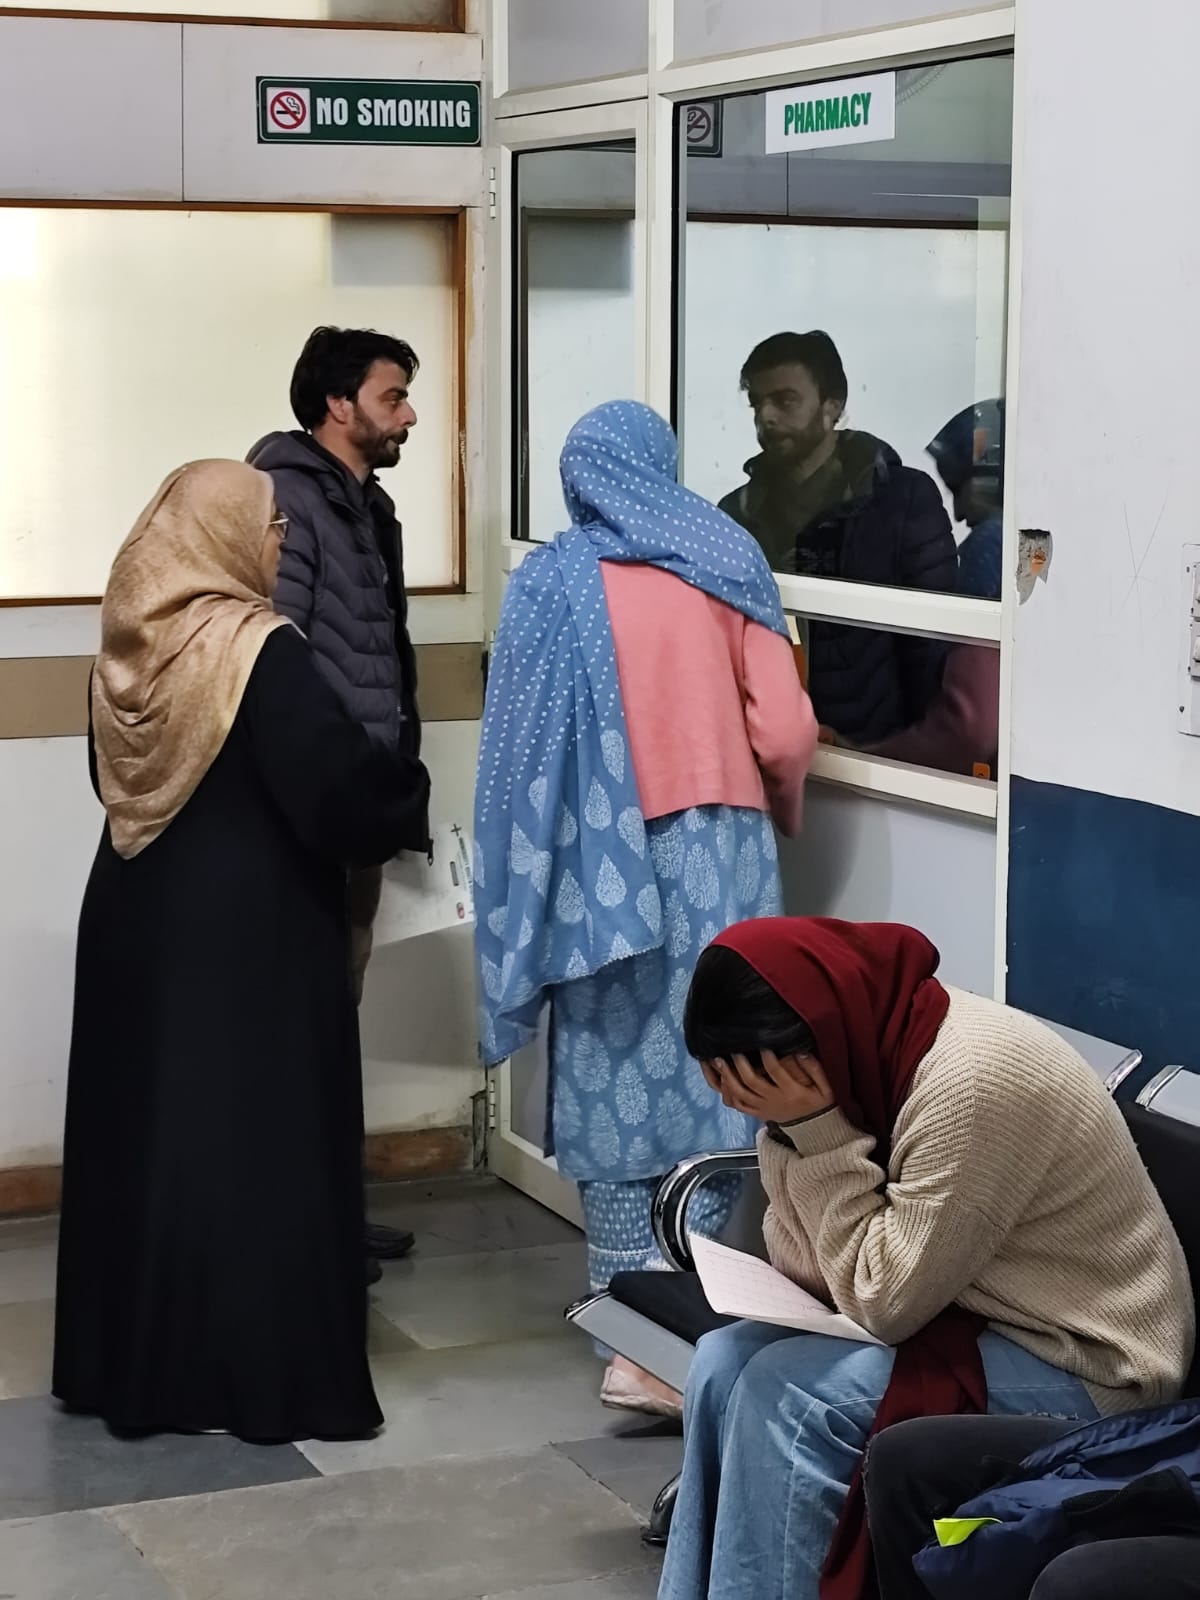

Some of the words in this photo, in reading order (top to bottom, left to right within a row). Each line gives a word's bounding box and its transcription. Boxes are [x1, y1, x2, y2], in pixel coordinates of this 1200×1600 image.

[316, 97, 348, 126] NO
[357, 98, 471, 128] SMOKING
[784, 92, 872, 136] PHARMACY
